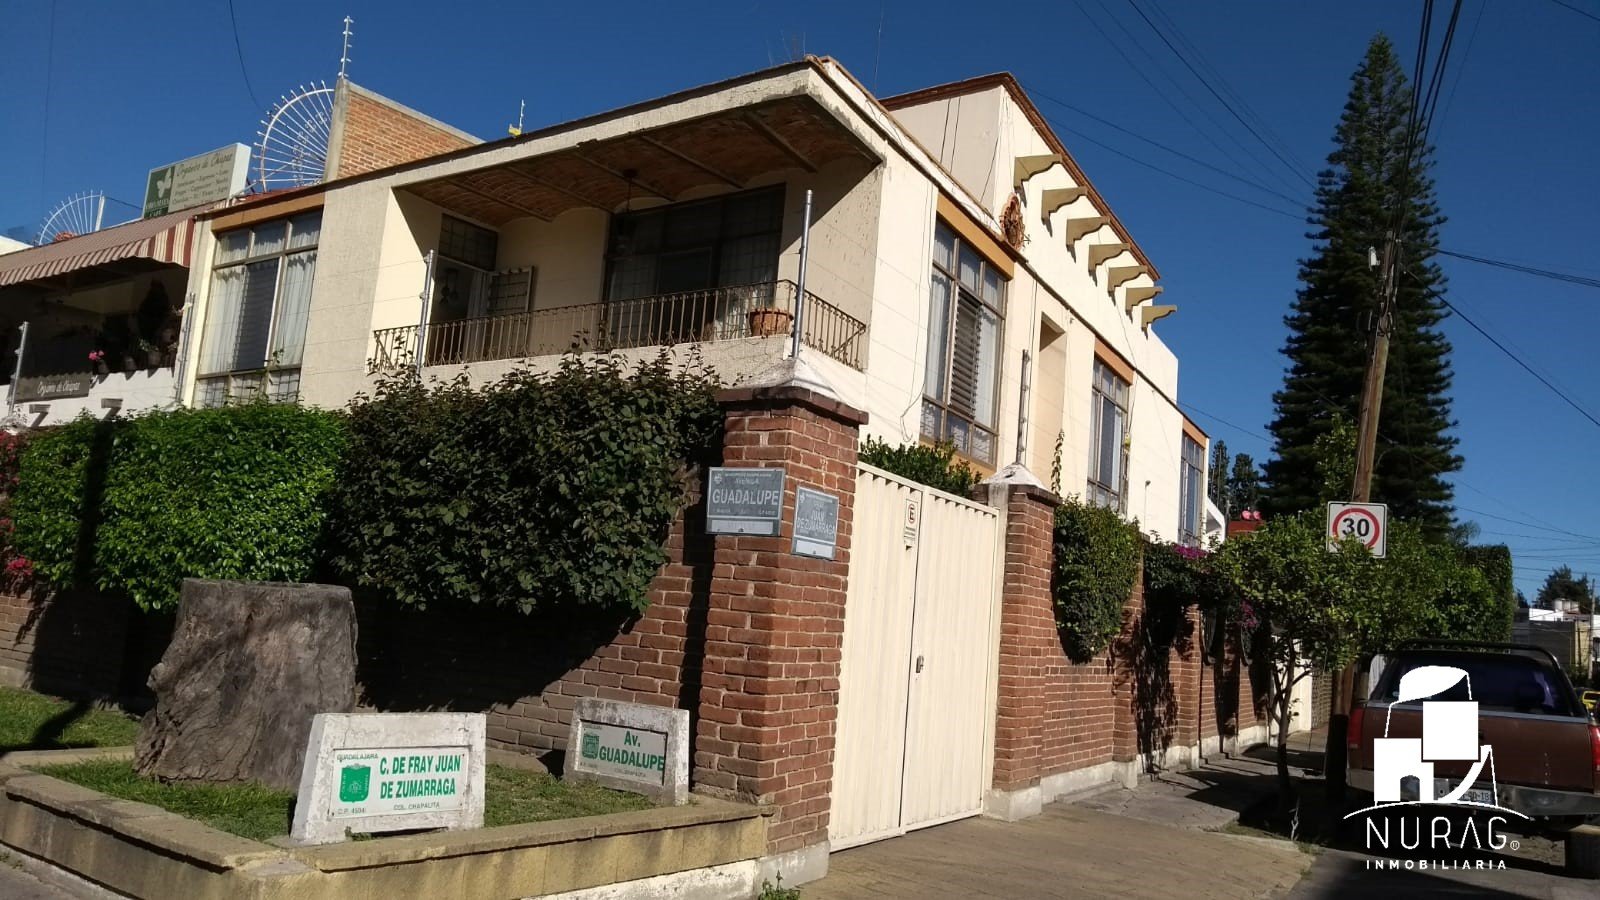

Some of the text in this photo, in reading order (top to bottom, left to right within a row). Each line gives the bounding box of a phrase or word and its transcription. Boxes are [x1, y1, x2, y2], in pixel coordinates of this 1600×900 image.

[712, 488, 780, 506] GUADALUPE
[1342, 517, 1370, 537] 30
[624, 731, 641, 747] Av.
[380, 755, 461, 775] C. DE FRAY JUAN
[599, 746, 665, 771] GUADALUPE
[380, 780, 394, 799] DE
[395, 778, 456, 798] ZUMARRAGA
